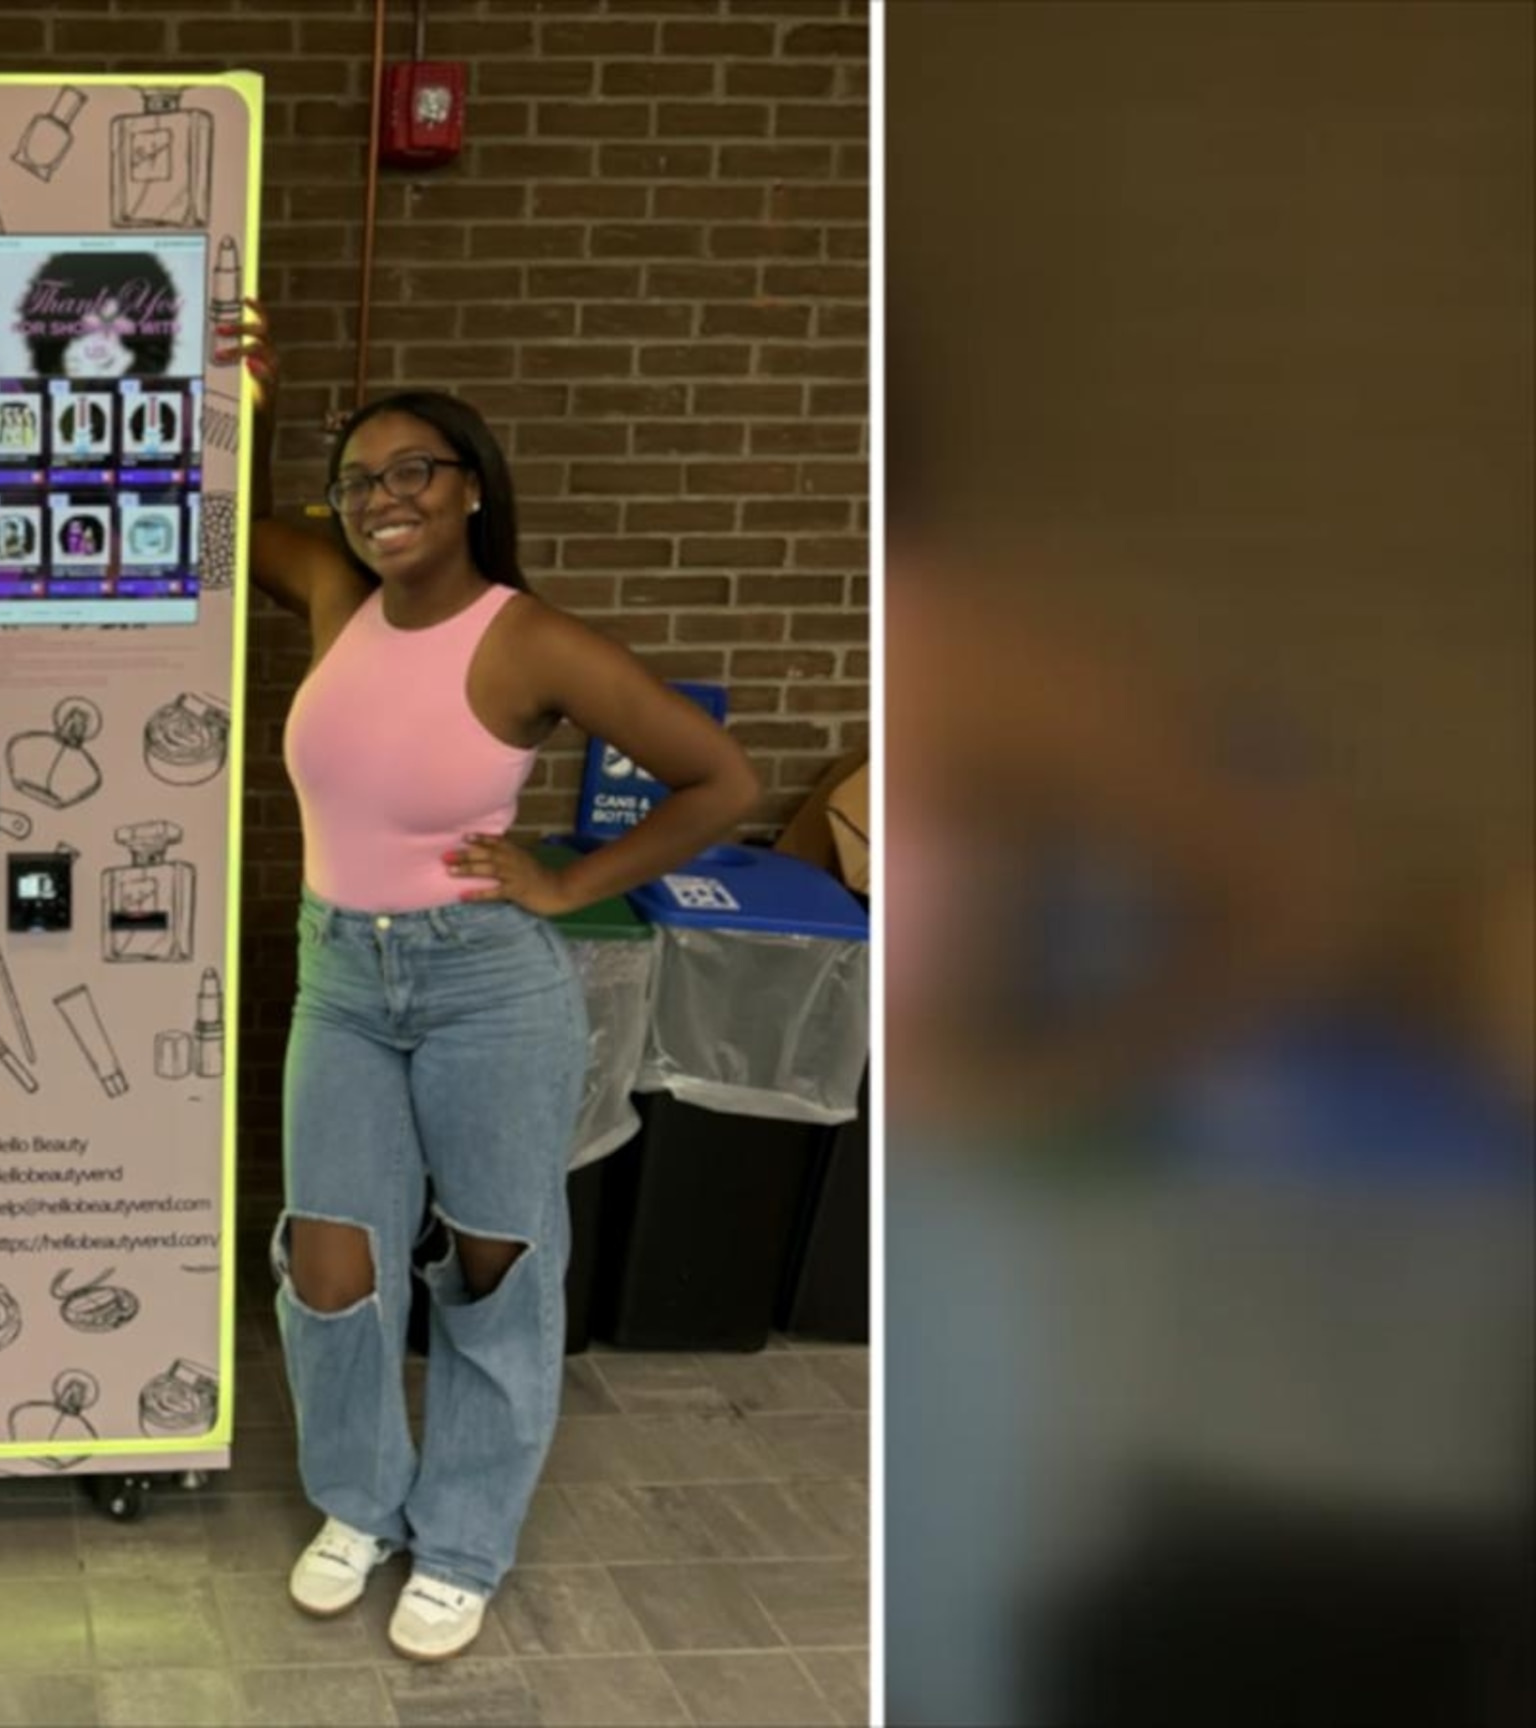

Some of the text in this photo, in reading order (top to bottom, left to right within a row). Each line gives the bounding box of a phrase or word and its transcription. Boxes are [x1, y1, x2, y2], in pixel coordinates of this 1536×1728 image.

[22, 279, 116, 318] Thank
[594, 793, 637, 808] CANS
[591, 809, 646, 824] BOTTL
[33, 1137, 89, 1156] Beauty
